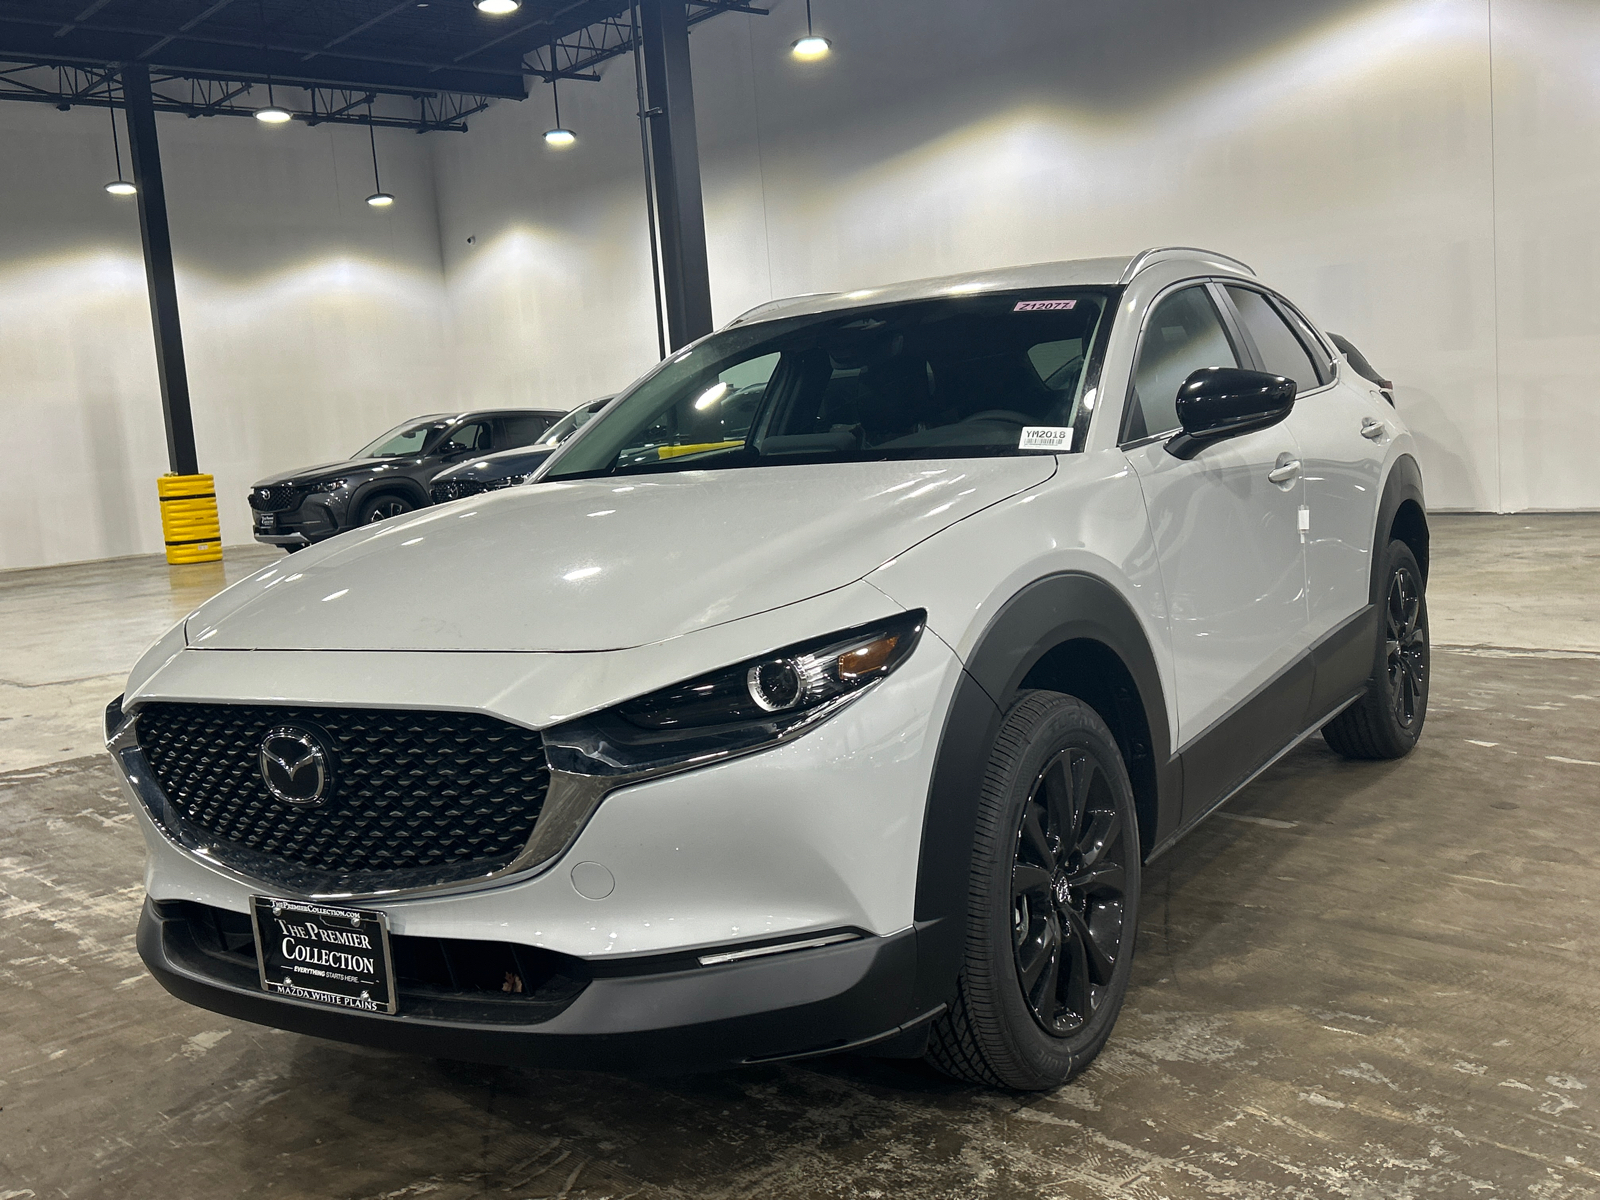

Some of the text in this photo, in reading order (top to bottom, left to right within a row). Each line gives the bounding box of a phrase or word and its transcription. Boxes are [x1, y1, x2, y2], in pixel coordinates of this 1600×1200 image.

[1026, 430, 1066, 439] YM2018
[293, 966, 326, 977] EVERYTHING
[325, 971, 345, 981] STARTS
[277, 985, 378, 1011] MAZDA WHITE PLAINS
